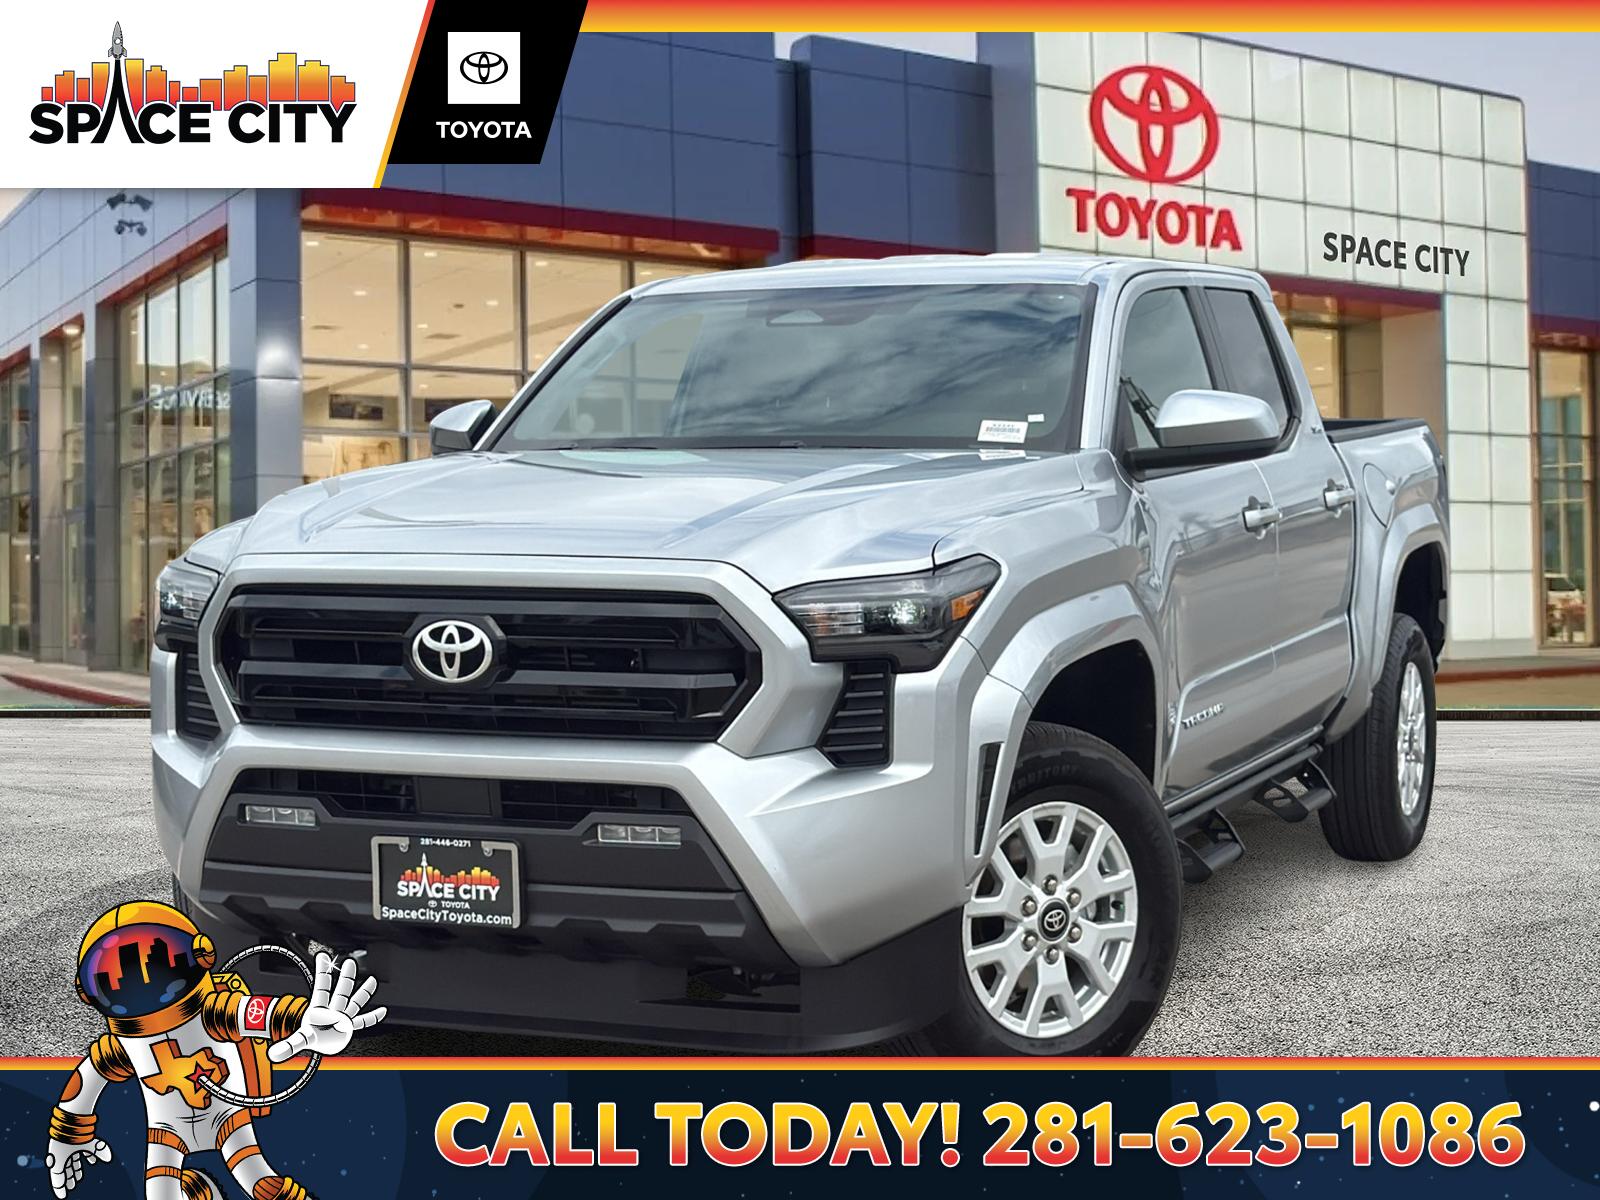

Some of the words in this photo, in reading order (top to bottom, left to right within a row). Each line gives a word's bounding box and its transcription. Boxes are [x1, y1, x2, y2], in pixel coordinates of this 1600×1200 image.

[1066, 188, 1242, 251] TOYOTA
[1323, 232, 1407, 270] SPACE
[1414, 245, 1470, 277] CITY
[420, 837, 471, 848] 281-446-0271
[397, 866, 455, 899] SPACE
[459, 884, 500, 901] CITY
[382, 906, 512, 926] SpaceCityToyota.com
[441, 900, 470, 910] TOYOTA
